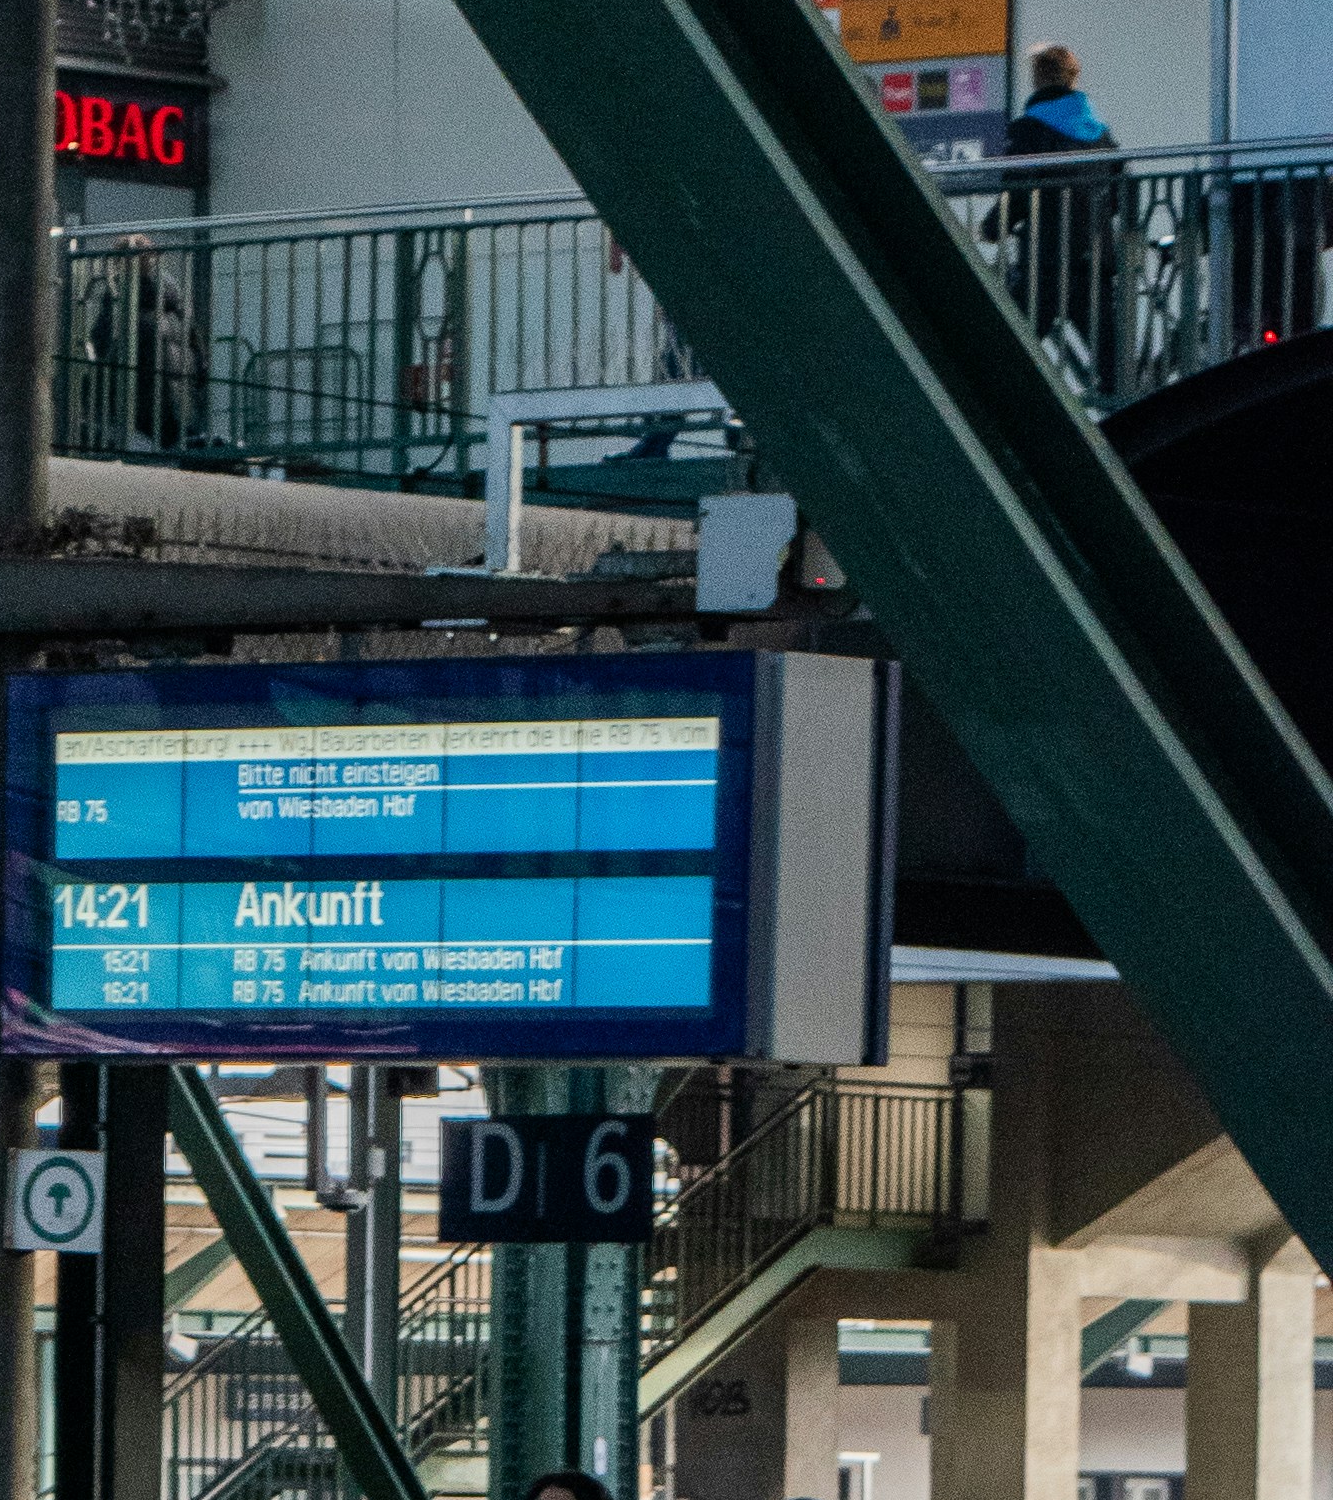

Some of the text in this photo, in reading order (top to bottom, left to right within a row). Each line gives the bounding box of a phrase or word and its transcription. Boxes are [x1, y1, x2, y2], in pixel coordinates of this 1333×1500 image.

[320, 728, 427, 753] Bauarbeiten
[436, 727, 520, 750] verkehrt
[527, 726, 553, 748] die
[559, 725, 601, 747] Linie
[610, 723, 631, 746] RB
[638, 722, 660, 745] 75
[238, 760, 439, 787] Bitte nicht einsteigen
[56, 799, 108, 823] RB 75
[238, 793, 417, 820] von Wiesbaden Hbf
[55, 881, 385, 929] 14:21 Ankunft
[104, 946, 564, 973] 15:21 RB 75 Ankunft von Wiesbaden Hbf
[104, 978, 564, 1005] 16:21 RB 75 Ankunft von Wiesbaden Hbf
[469, 1119, 633, 1215] D 6
